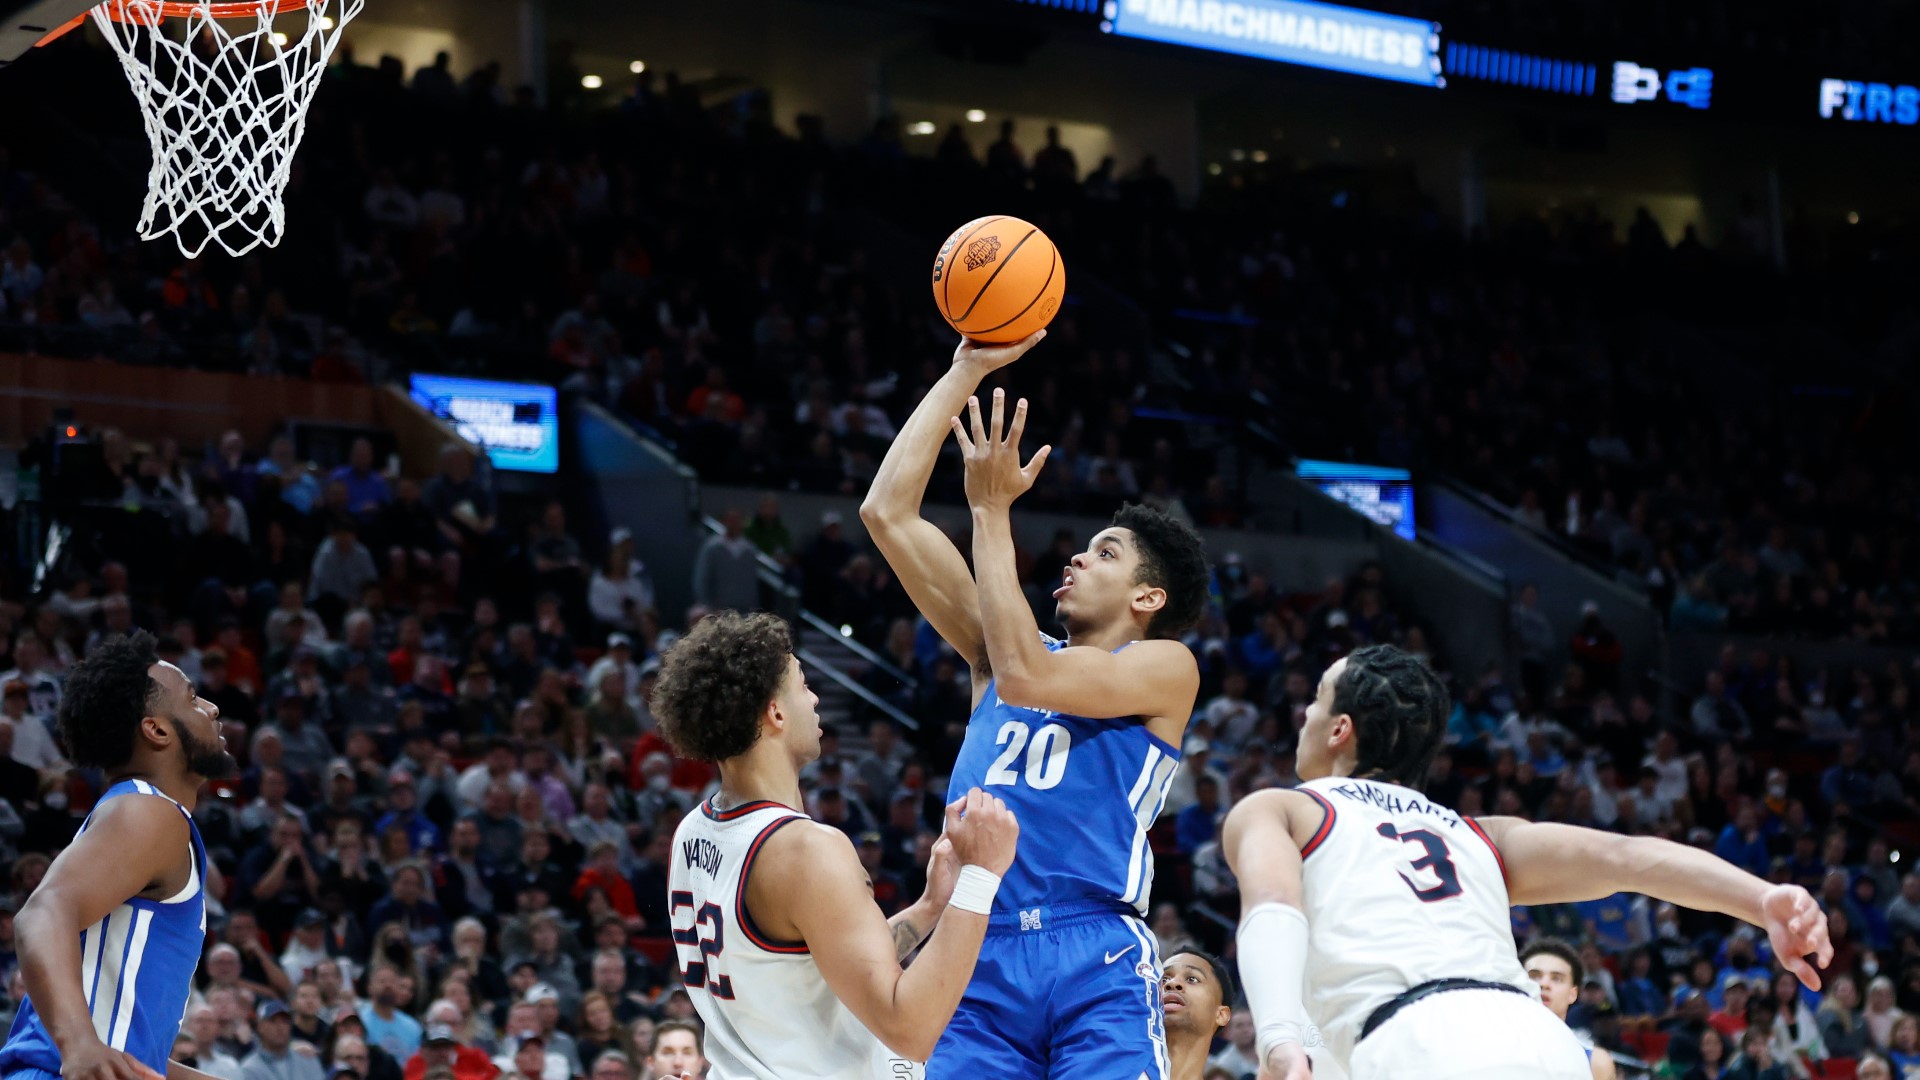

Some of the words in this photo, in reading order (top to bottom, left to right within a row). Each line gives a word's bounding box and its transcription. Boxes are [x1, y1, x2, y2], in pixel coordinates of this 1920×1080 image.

[1820, 78, 1920, 125] FIRS
[969, 238, 987, 258] FINAL
[975, 242, 993, 265] FOUR
[984, 720, 1071, 790] 20
[683, 838, 723, 881] WATSON
[1376, 822, 1464, 902] 3
[671, 890, 735, 1000] 22
